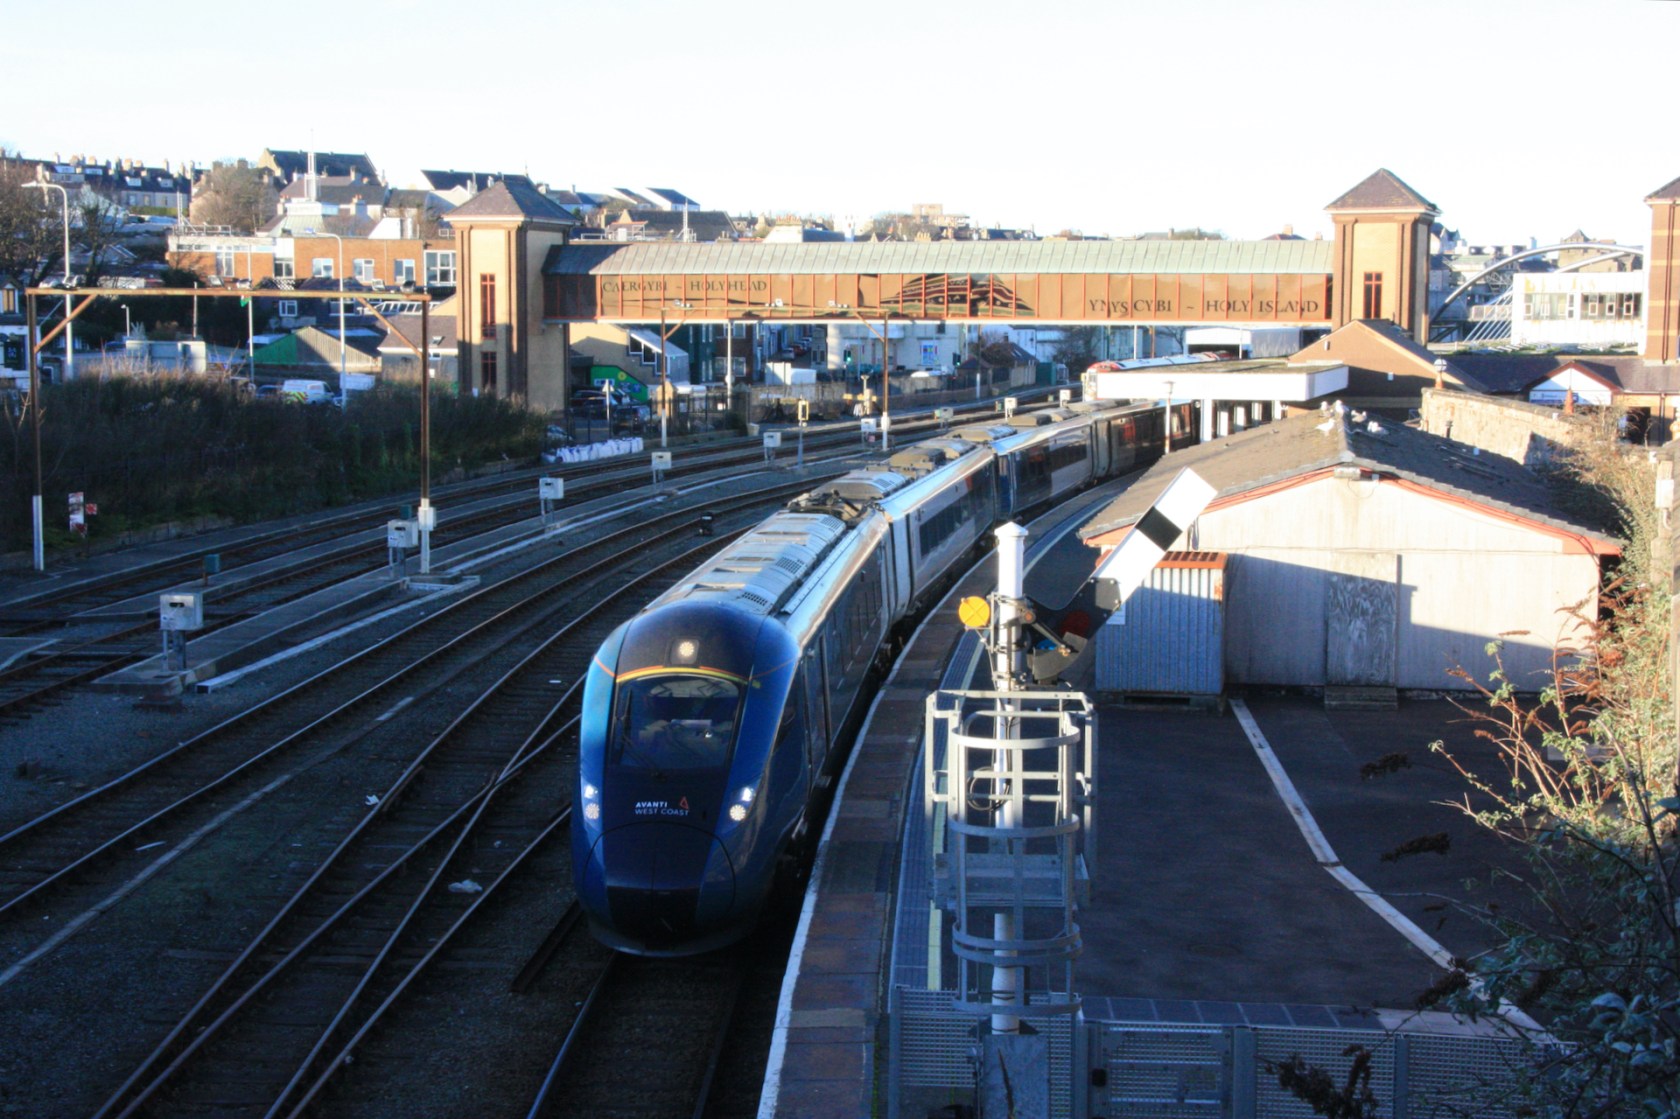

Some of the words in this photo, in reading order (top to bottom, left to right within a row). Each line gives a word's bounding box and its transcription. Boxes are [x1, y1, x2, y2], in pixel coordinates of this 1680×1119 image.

[602, 281, 667, 293] CAERGYBI
[690, 280, 767, 292] HOLYHEAD
[1089, 299, 1128, 314] YNYS
[1133, 299, 1172, 312] CYBI
[1206, 299, 1250, 312] HOLY
[1258, 299, 1318, 314] ISLAND
[660, 808, 689, 816] COAST
